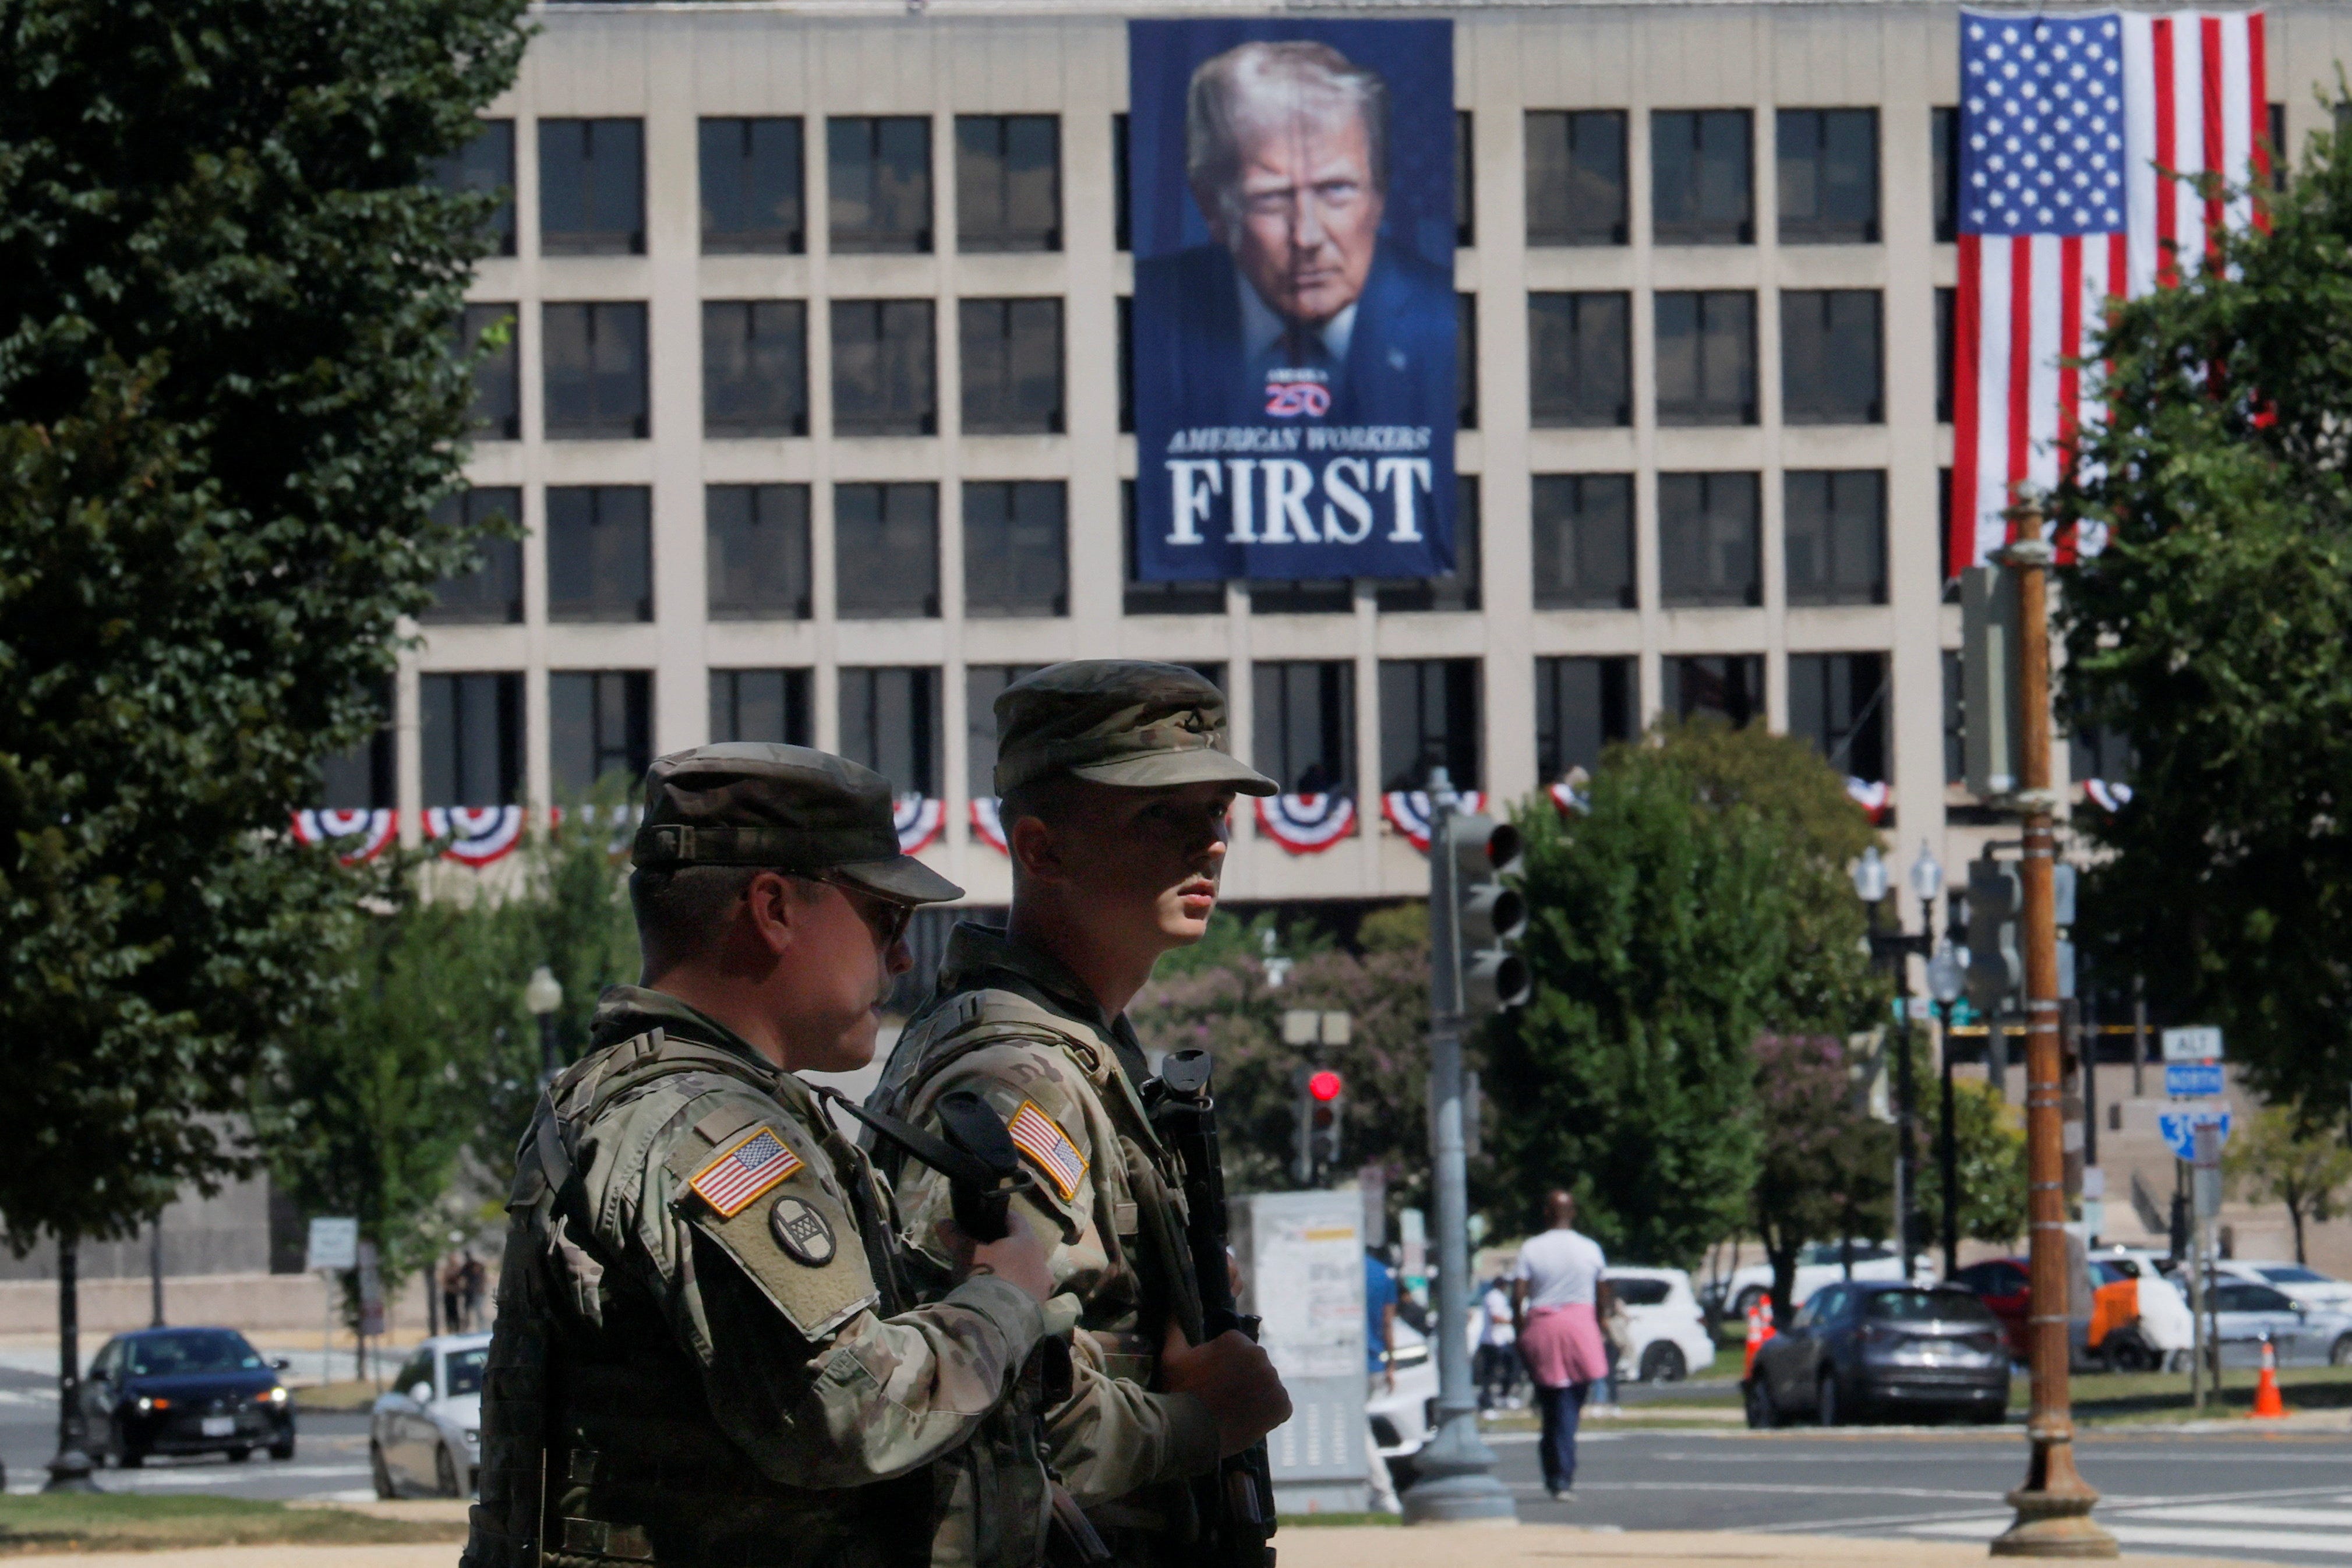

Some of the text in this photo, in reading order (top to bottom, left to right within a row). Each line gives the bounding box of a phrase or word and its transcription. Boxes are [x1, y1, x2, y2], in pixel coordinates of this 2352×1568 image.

[1265, 382, 1332, 417] 250
[1167, 426, 1432, 453] AMERICAN WORKERS
[1166, 457, 1432, 544] FIRST
